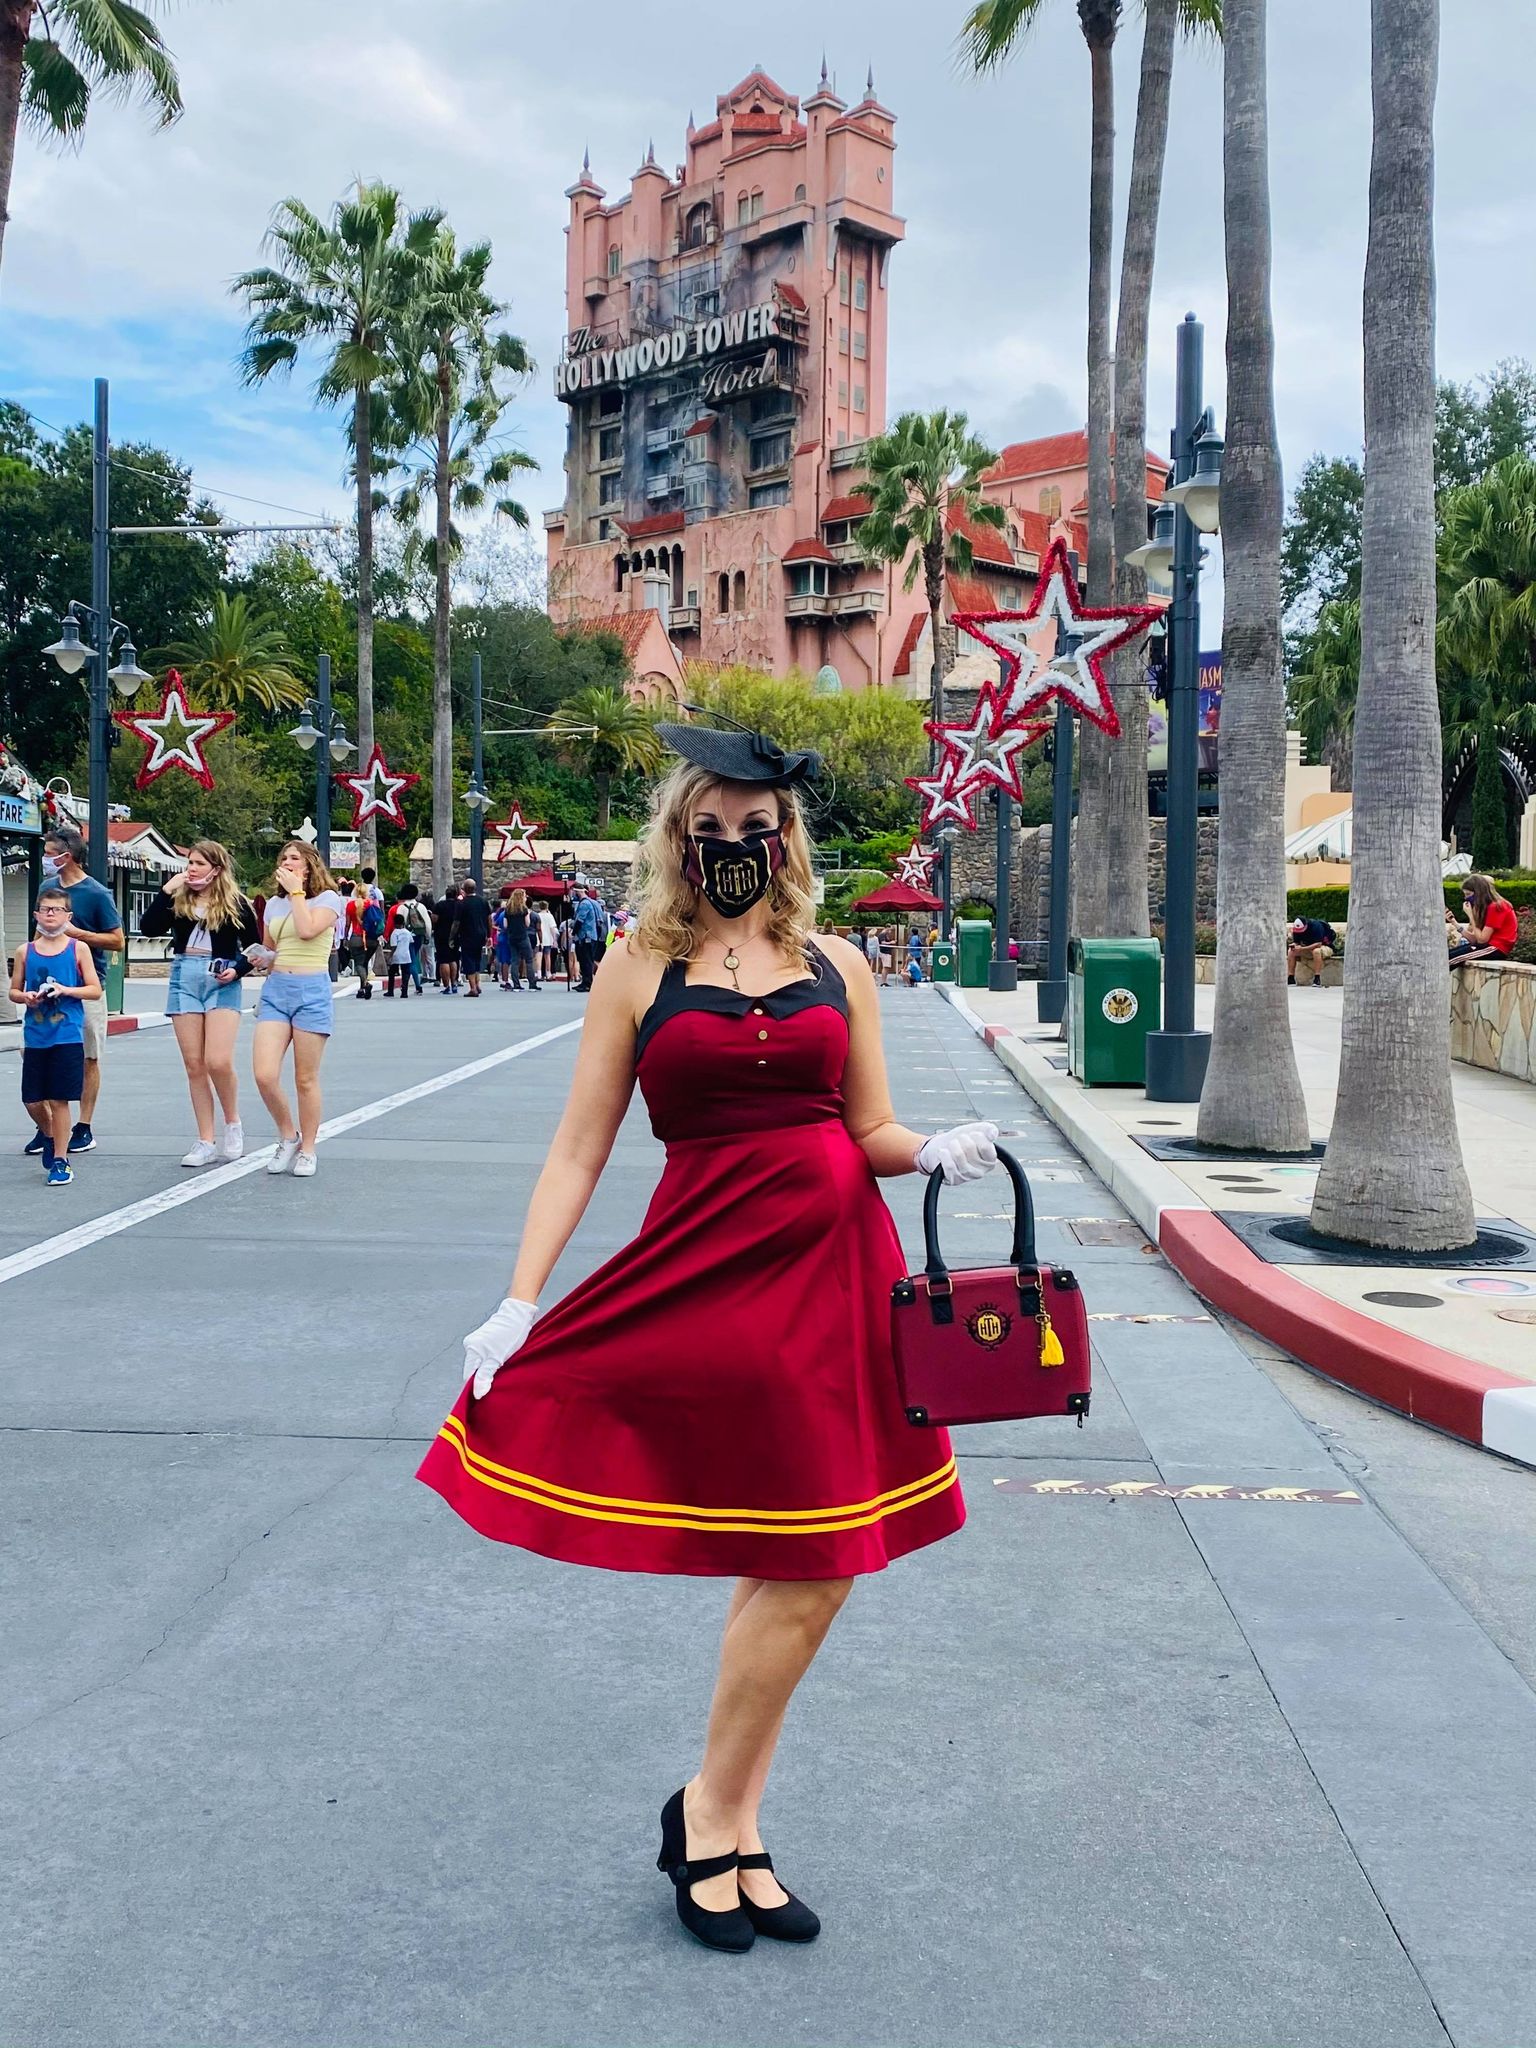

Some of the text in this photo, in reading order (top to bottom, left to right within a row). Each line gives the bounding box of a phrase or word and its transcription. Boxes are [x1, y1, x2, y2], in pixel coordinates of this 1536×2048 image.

[554, 301, 780, 395] HOLLYWOOD TOWER
[567, 325, 602, 355] The
[701, 348, 778, 400] Hotel
[0, 801, 23, 823] FARE
[980, 1318, 999, 1338] HTH
[1034, 1486, 1324, 1502] PLEASE WAIT HERE
